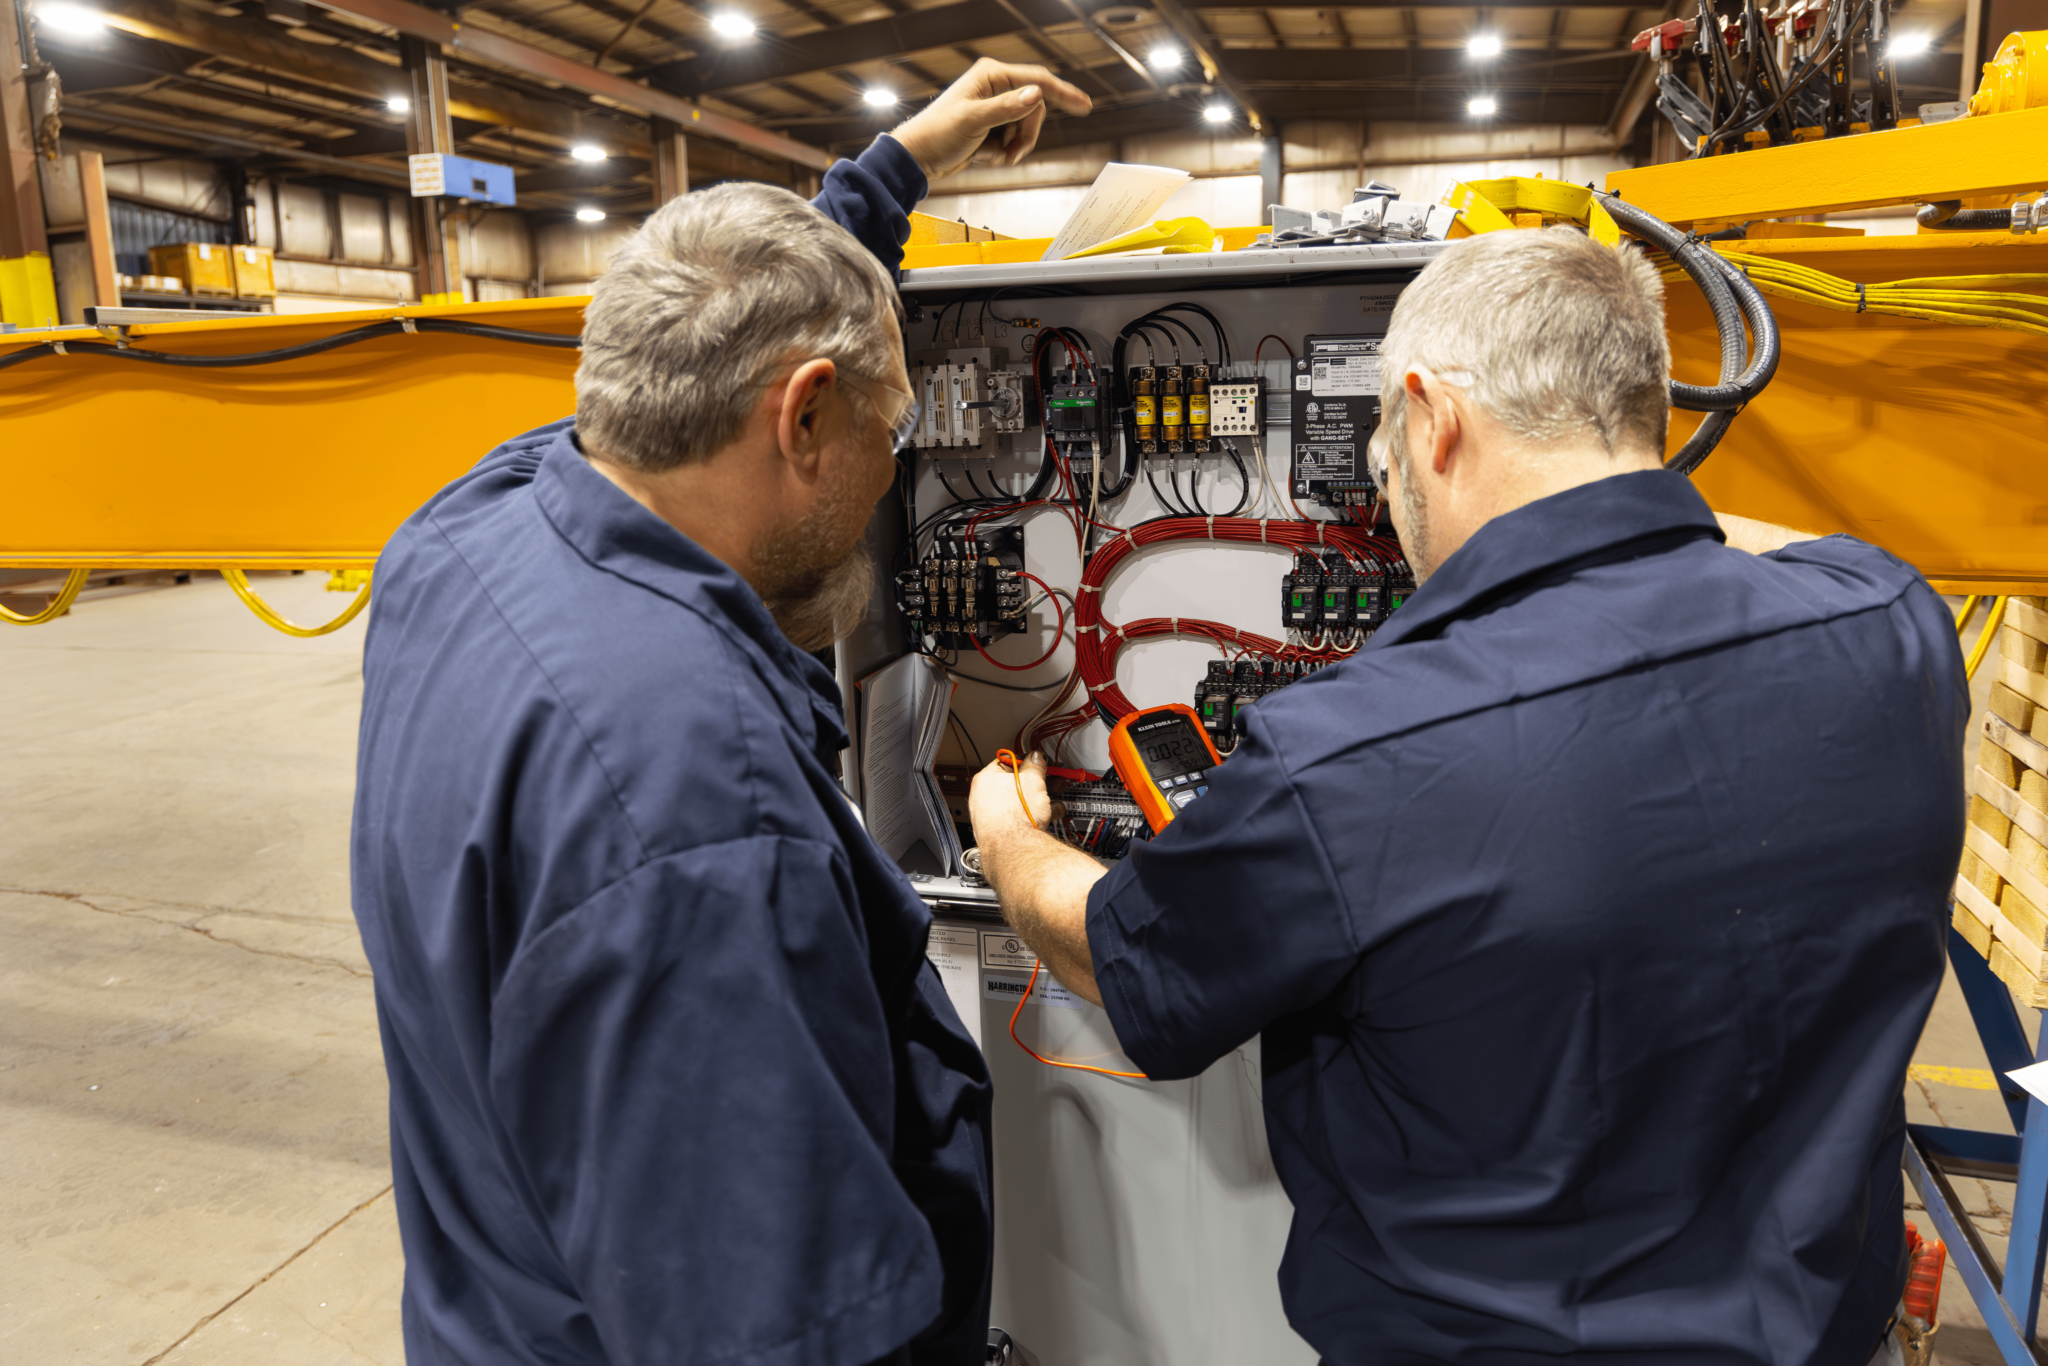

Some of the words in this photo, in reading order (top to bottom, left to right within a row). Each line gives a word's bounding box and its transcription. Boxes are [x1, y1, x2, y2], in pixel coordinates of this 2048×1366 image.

[941, 328, 955, 343] L1
[967, 326, 982, 341] L2
[994, 324, 1008, 339] L3
[1137, 723, 1155, 732] KLEIN
[1154, 719, 1172, 728] TOOLS
[1147, 737, 1195, 763] 0.022
